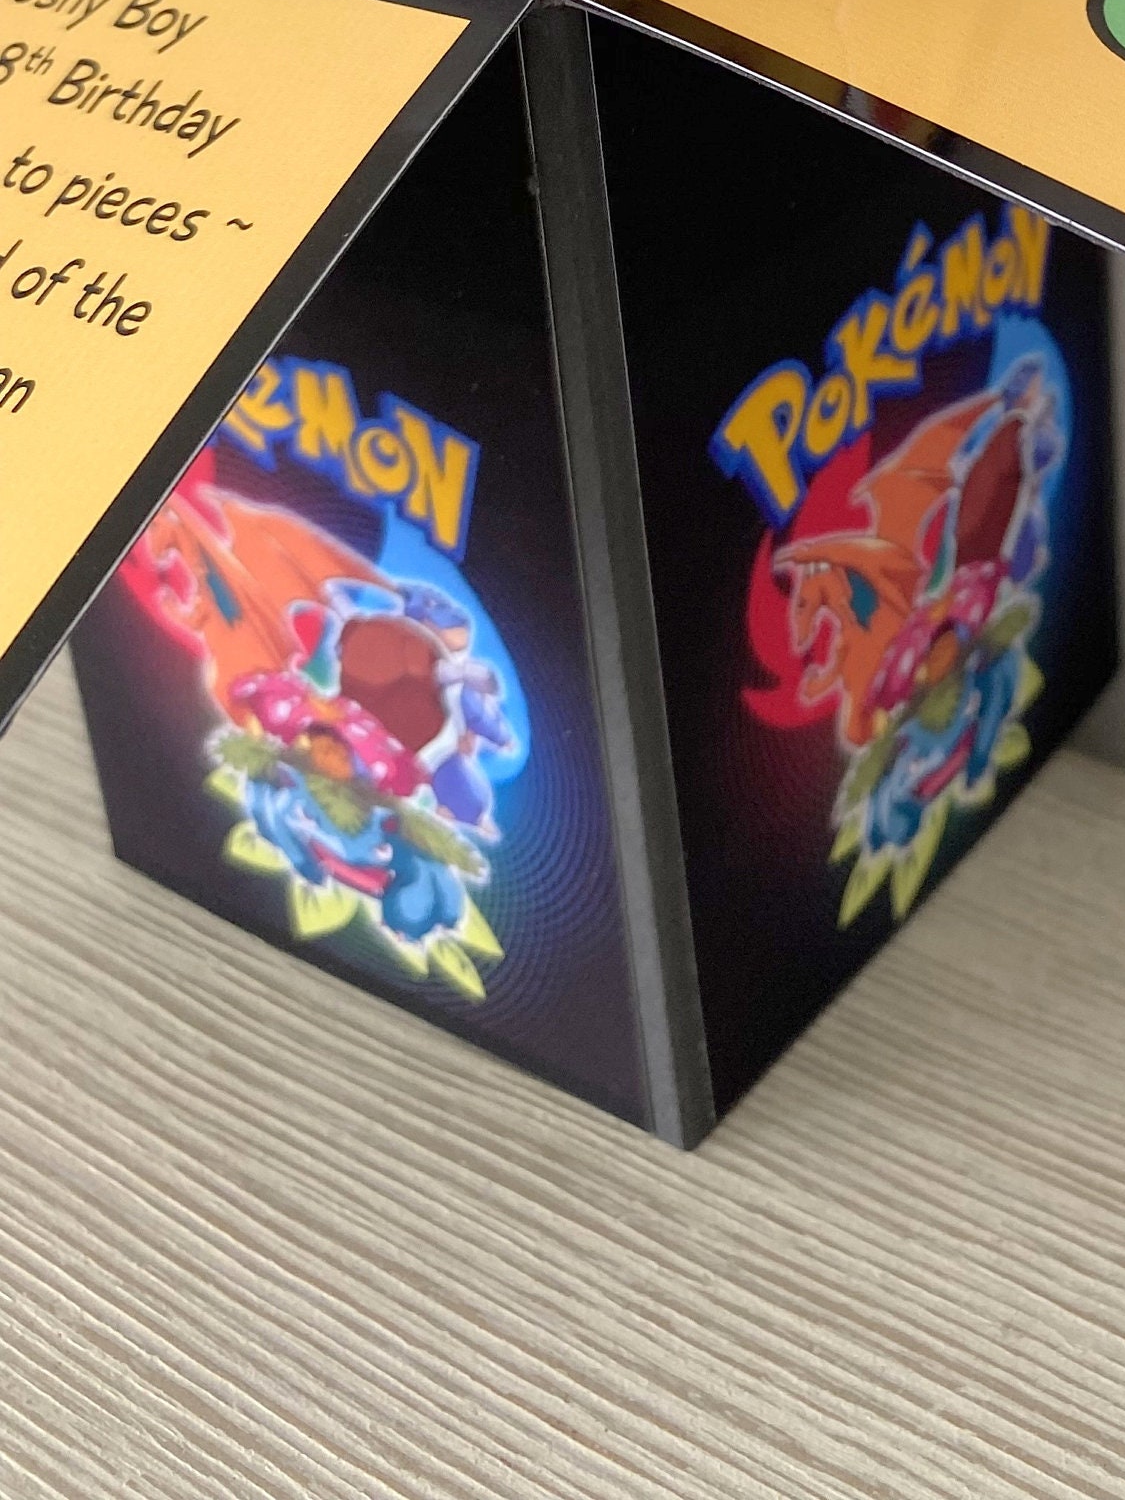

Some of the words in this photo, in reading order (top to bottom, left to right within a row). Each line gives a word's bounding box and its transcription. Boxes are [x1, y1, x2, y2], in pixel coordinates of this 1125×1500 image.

[47, 57, 243, 160] Birthday
[3, 145, 54, 194] to
[44, 172, 211, 241] pieces
[11, 258, 86, 306] of
[73, 271, 153, 336] the
